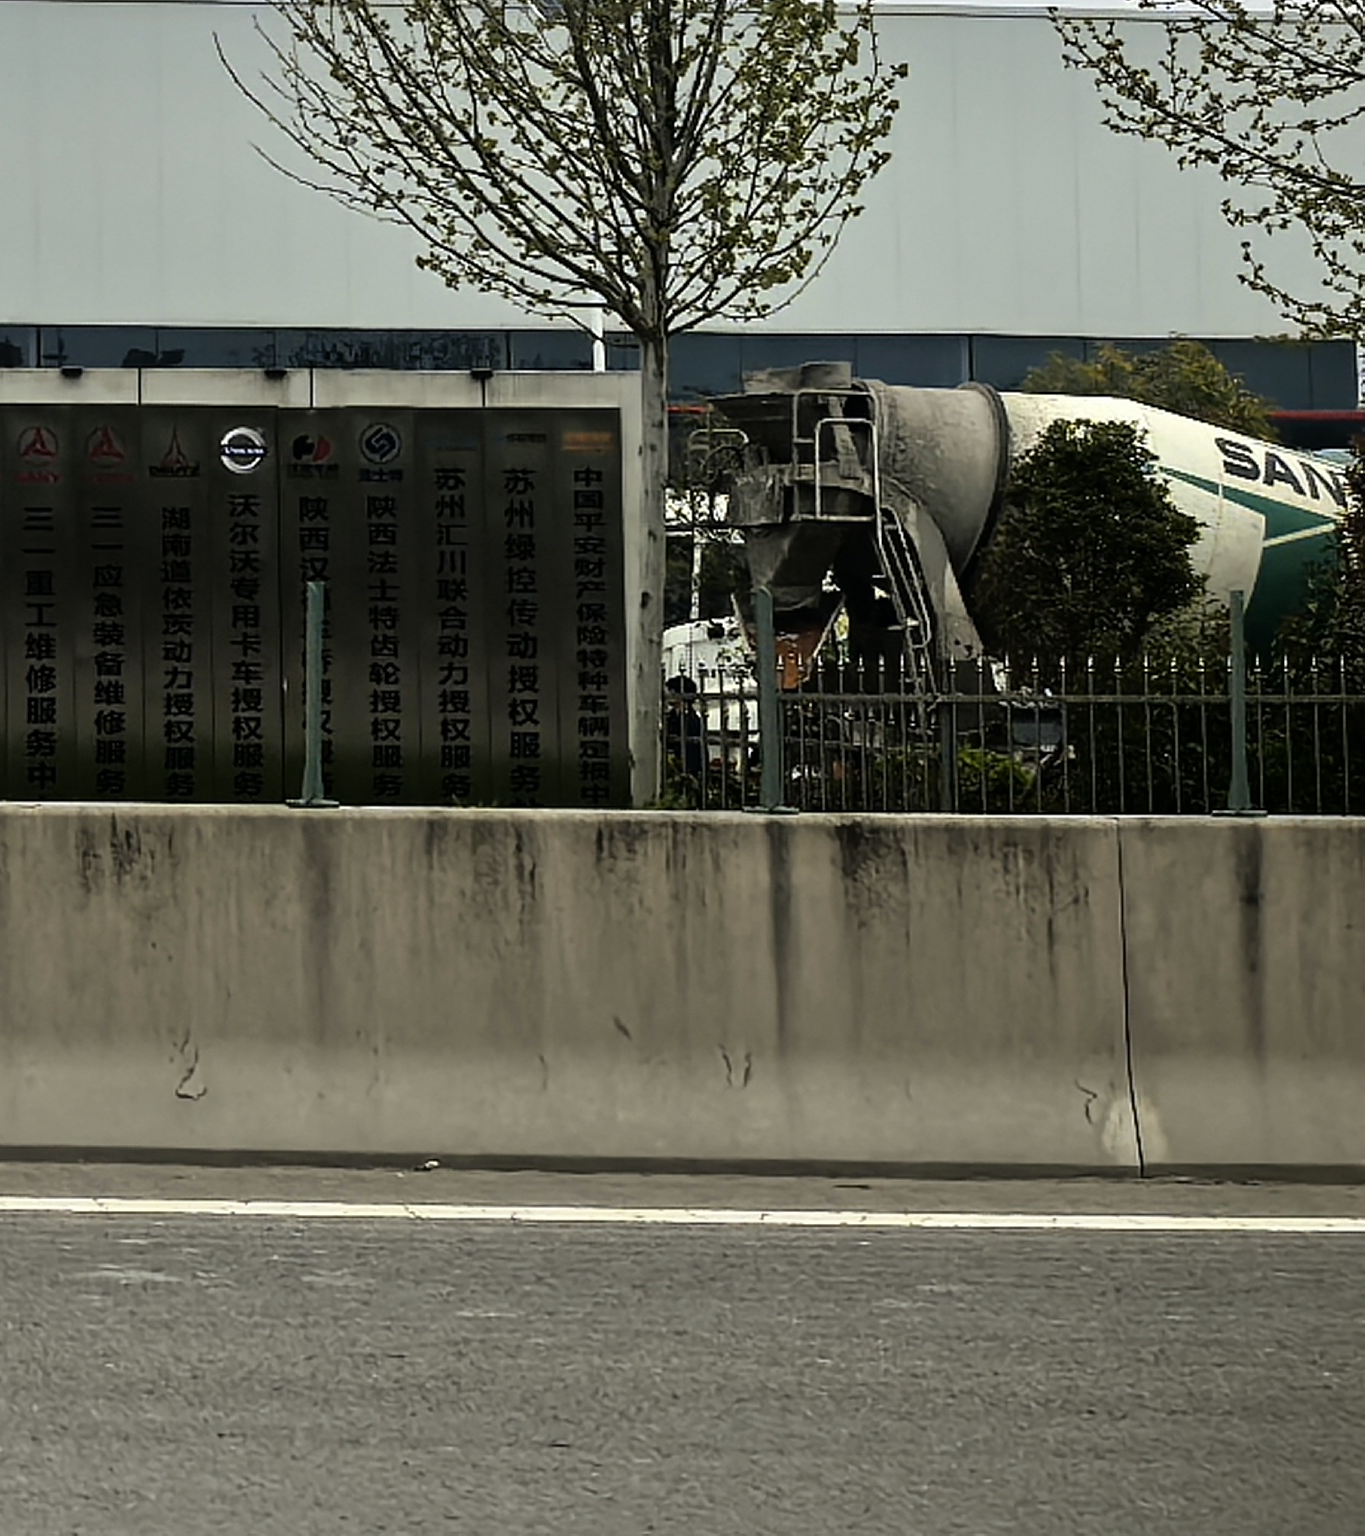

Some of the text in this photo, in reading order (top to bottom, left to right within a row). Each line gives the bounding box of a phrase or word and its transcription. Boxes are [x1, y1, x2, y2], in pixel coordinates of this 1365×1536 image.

[1214, 437, 1348, 510] SAN
[227, 494, 264, 797] 沃尔沃专用卡车授权服务
[367, 496, 404, 798] 陕西法士特齿轮授权服务
[433, 467, 471, 798] 苏州汇川联合动力授权服务
